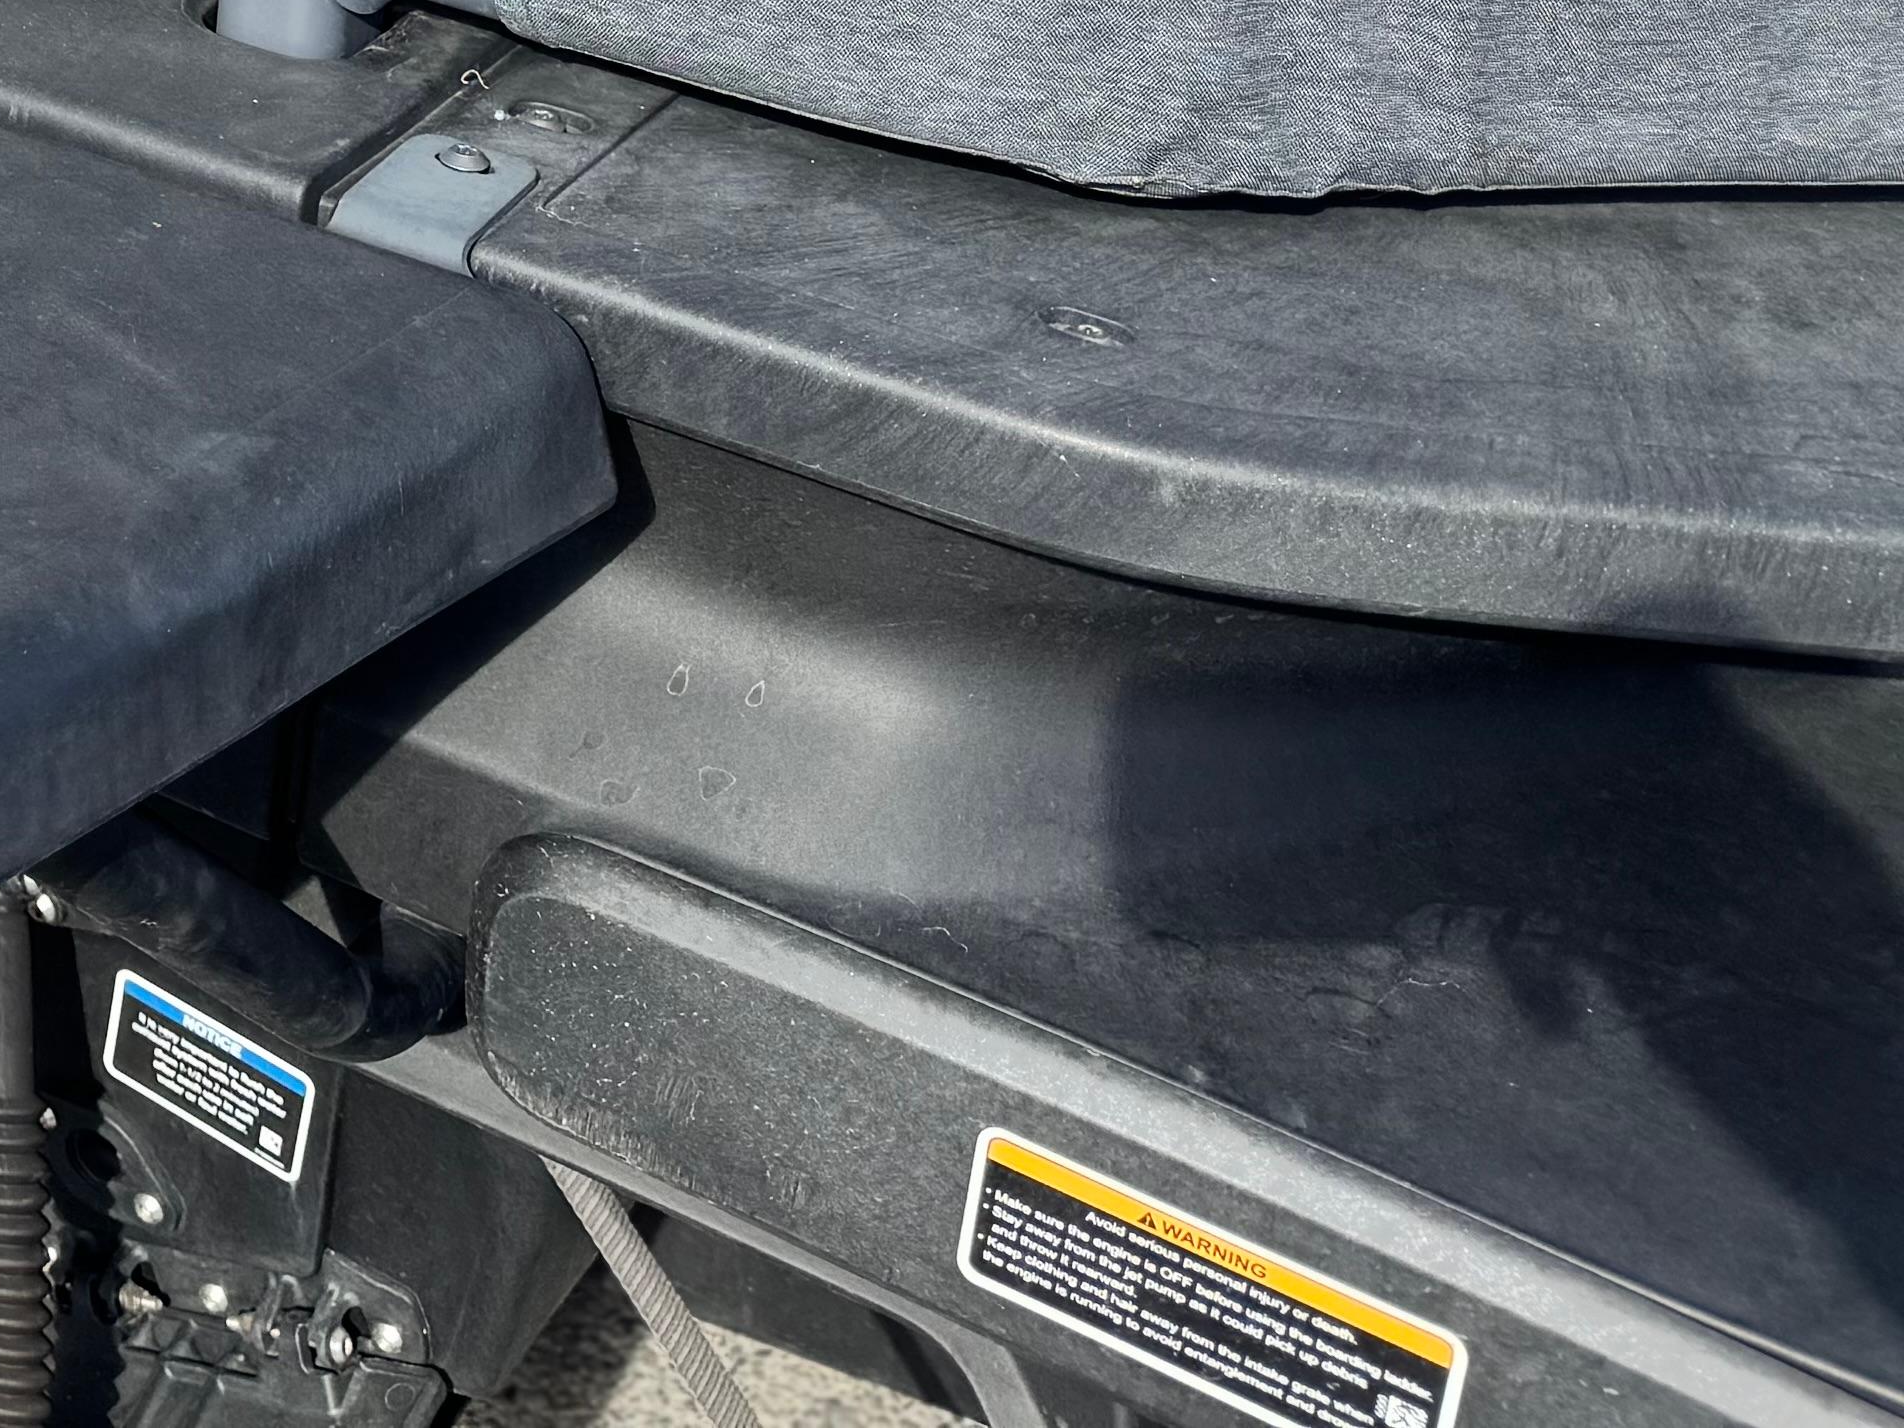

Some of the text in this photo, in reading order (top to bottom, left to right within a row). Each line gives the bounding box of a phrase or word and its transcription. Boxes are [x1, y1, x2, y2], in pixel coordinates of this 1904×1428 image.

[183, 1015, 243, 1059] NOTICE
[995, 1190, 1032, 1215] Make
[1160, 1267, 1193, 1287] OFF
[1085, 1212, 1126, 1237] Avoid
[1163, 1220, 1266, 1278] WARNING
